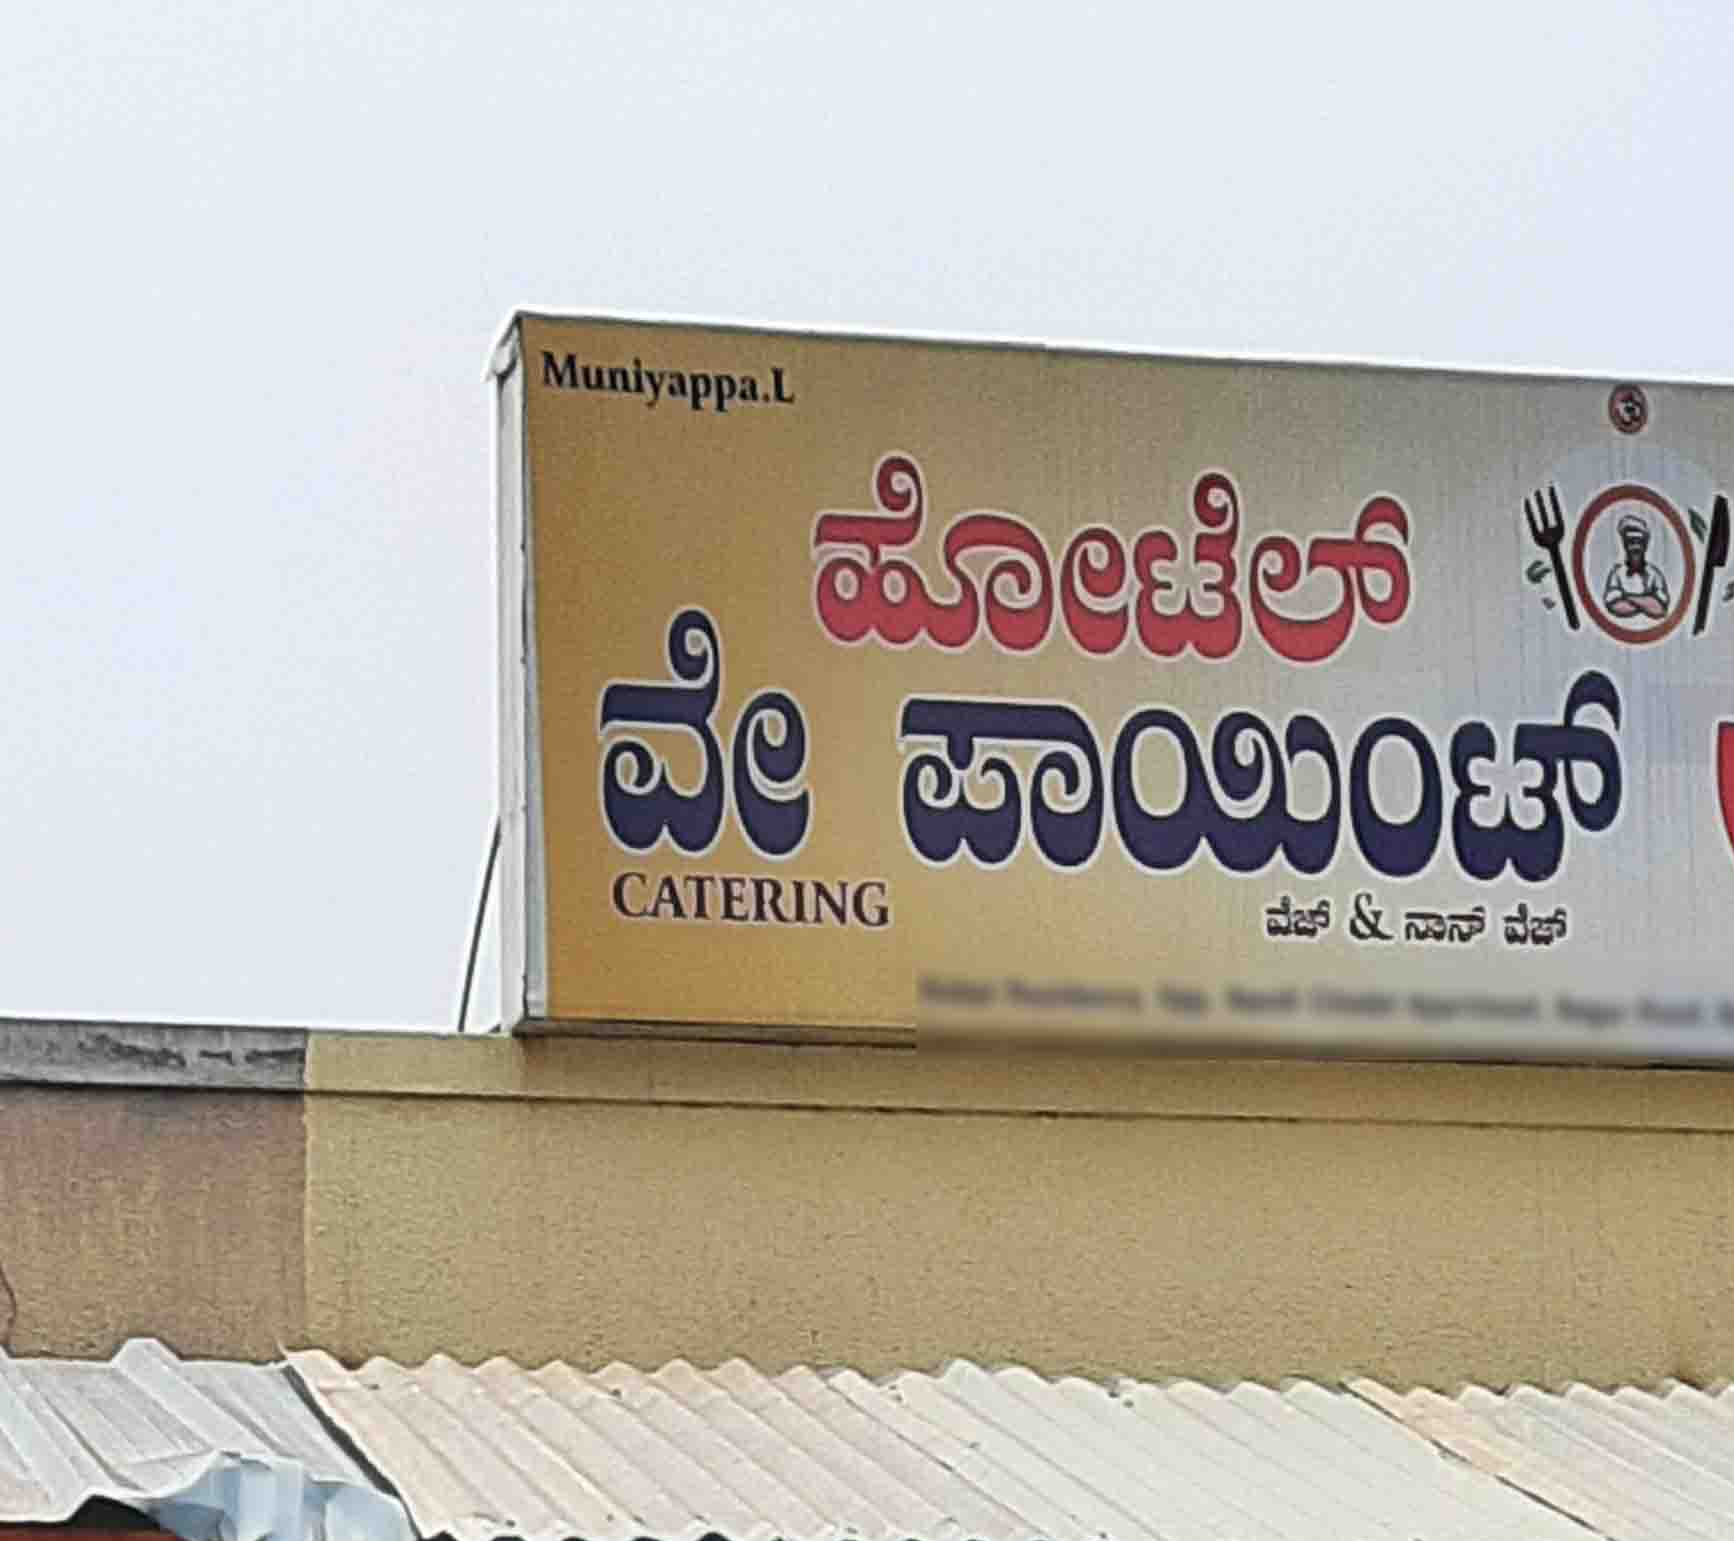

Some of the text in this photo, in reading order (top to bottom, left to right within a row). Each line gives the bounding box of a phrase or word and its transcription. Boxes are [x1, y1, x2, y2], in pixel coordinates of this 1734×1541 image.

[541, 351, 795, 411] Muniyappa.L
[812, 452, 1412, 665] ಹೋಟೆಲ್
[600, 610, 1624, 882] ವೇ ಪಾಯಿಂಟ್
[612, 871, 891, 928] CATERING
[1350, 892, 1394, 941] &
